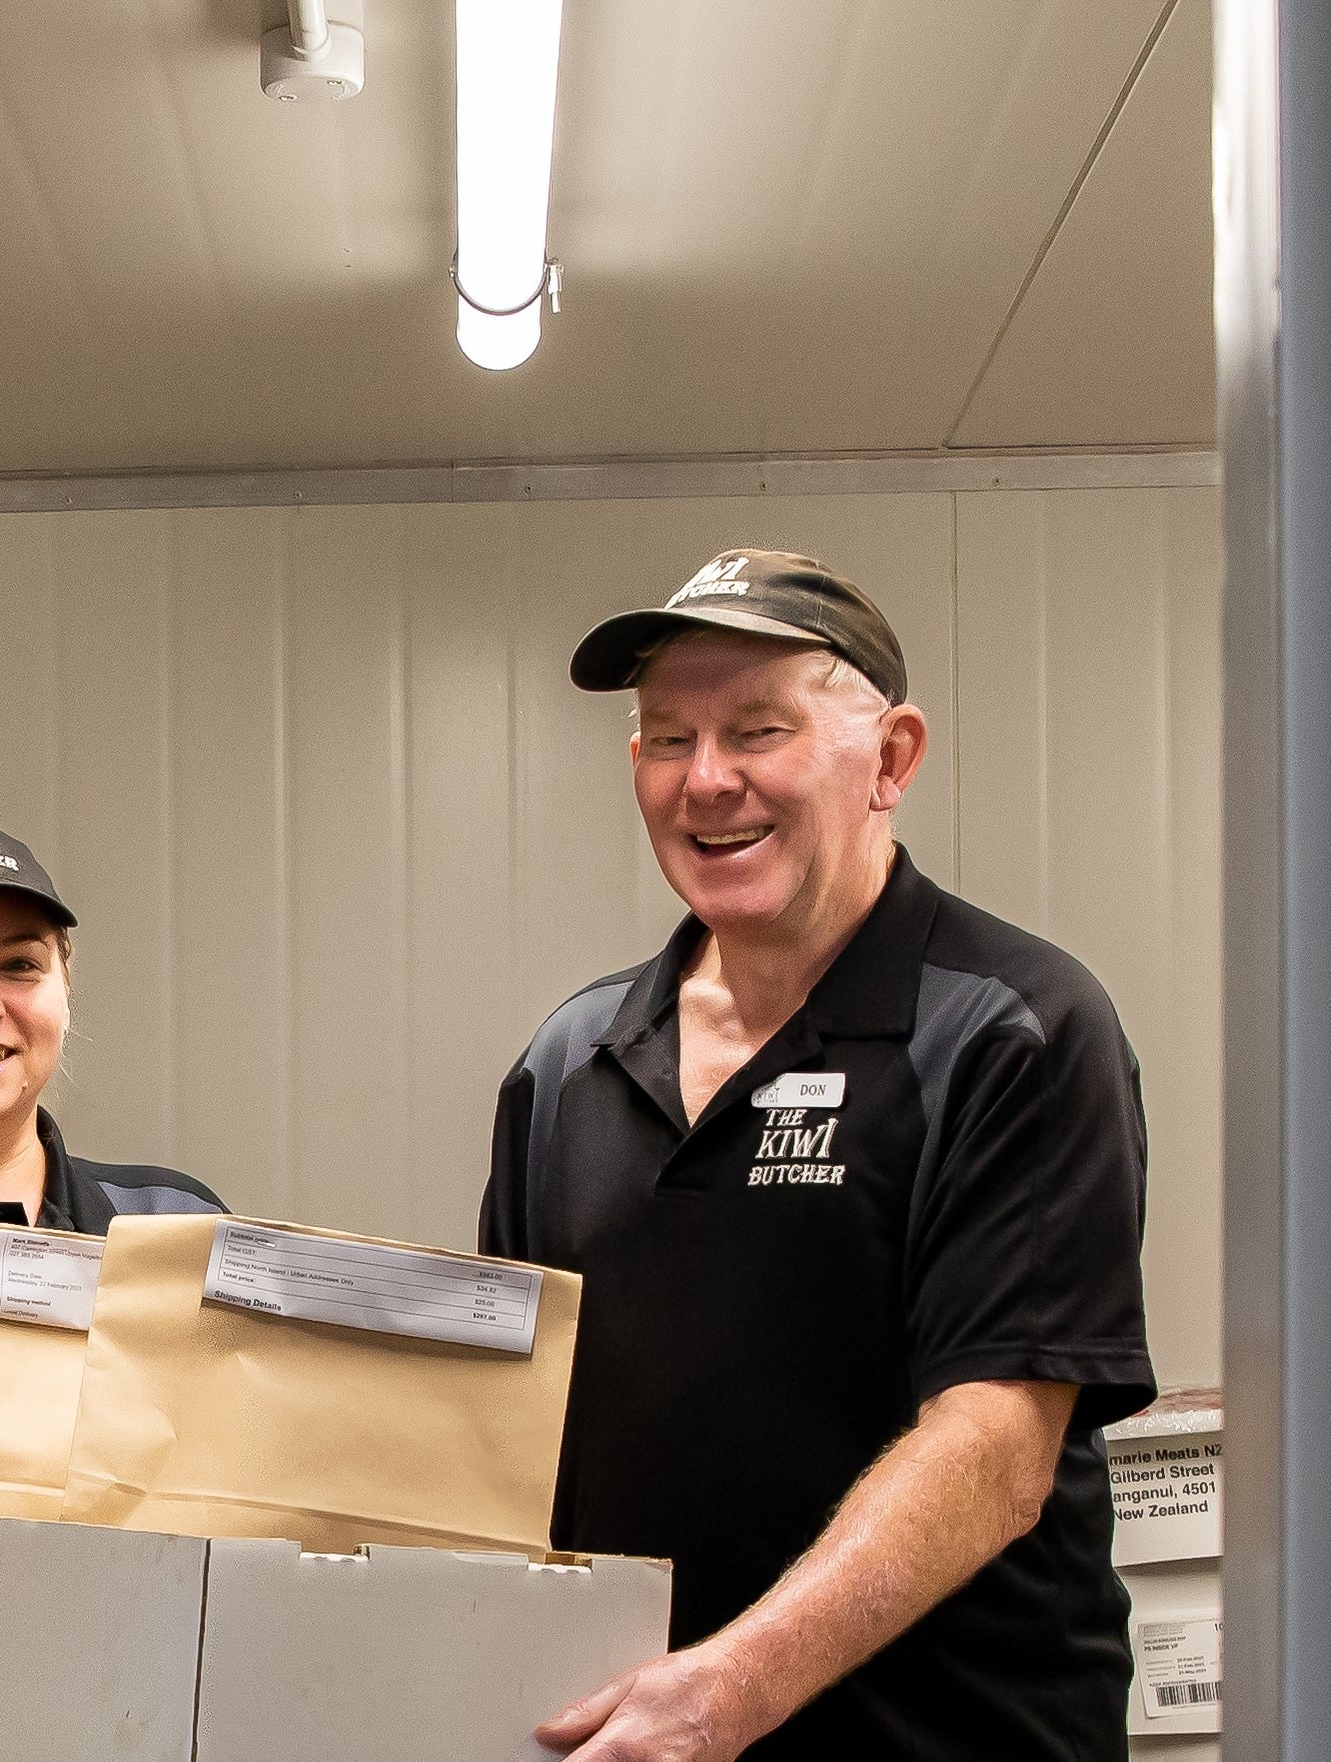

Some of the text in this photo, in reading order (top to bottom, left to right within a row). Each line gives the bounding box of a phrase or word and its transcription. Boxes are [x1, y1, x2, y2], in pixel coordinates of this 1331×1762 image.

[800, 1084, 827, 1096] DON
[766, 1108, 808, 1126] THE
[755, 1118, 839, 1159] KIWI
[747, 1164, 846, 1186] BUTCHER
[223, 1271, 238, 1279] Total
[6, 1295, 31, 1306] Shipping
[214, 1290, 282, 1311] Shipping Details
[1109, 1450, 1152, 1466] marie
[1155, 1447, 1200, 1462] Meats
[1110, 1462, 1215, 1485] Gilberd Street
[1113, 1481, 1215, 1504] anganui, 4501
[1148, 1500, 1209, 1518] Zealand
